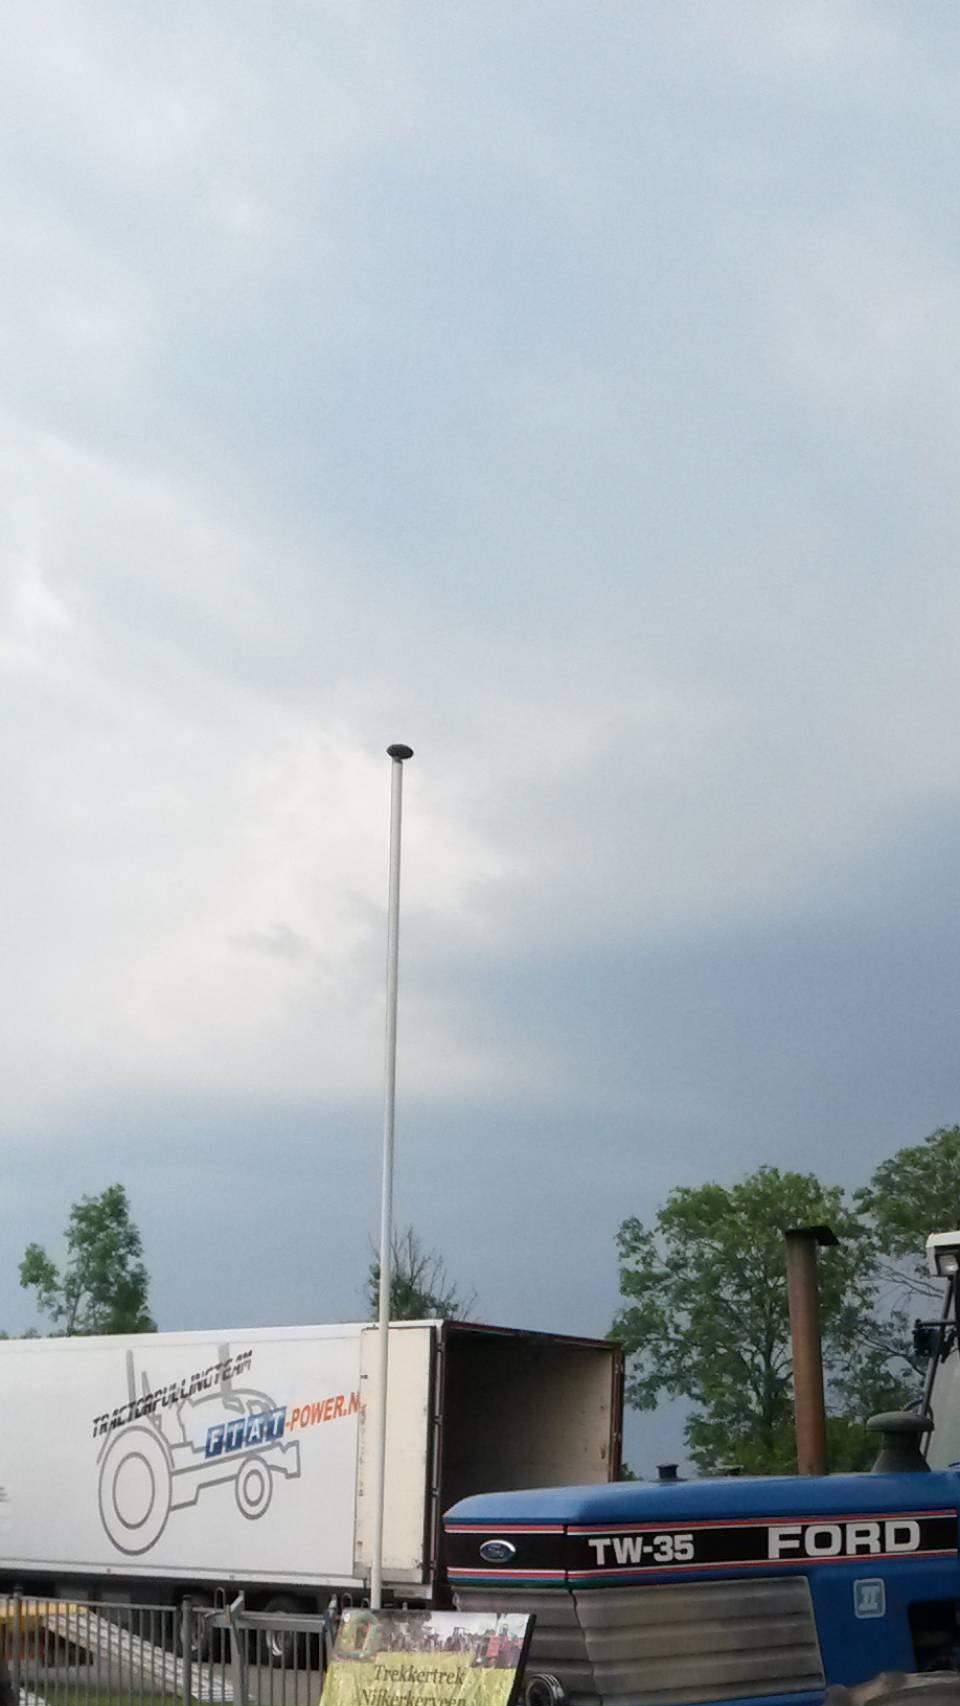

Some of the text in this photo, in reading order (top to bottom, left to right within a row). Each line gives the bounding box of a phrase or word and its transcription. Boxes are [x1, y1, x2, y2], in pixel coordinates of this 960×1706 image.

[92, 1349, 253, 1438] TRACTORPULLINGTEAM
[588, 1533, 695, 1565] TW-35
[767, 1520, 920, 1559] FORD
[374, 1664, 466, 1685] Trekkertrek
